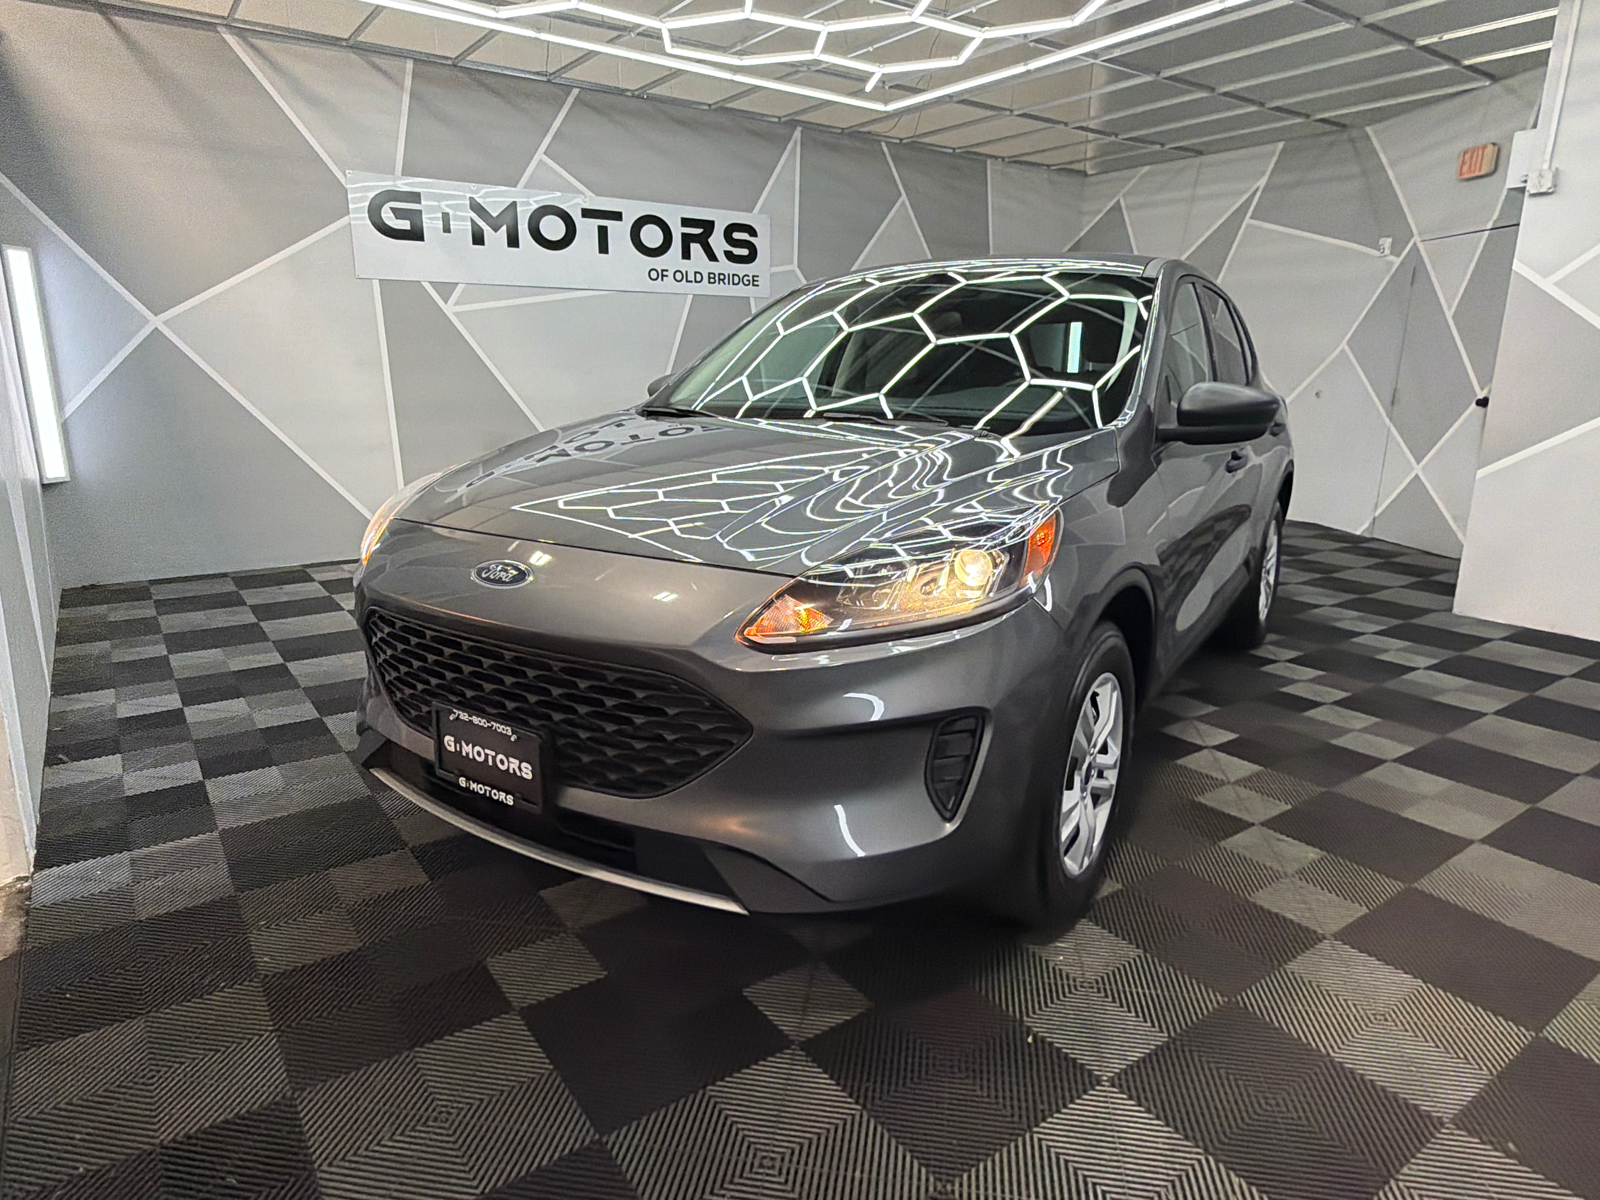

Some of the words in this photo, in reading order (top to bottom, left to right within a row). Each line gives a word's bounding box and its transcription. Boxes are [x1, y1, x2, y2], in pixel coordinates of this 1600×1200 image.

[648, 268, 669, 283] OF
[673, 270, 704, 285] OLD
[707, 272, 761, 287] BRIDGE
[481, 564, 519, 582] Ford
